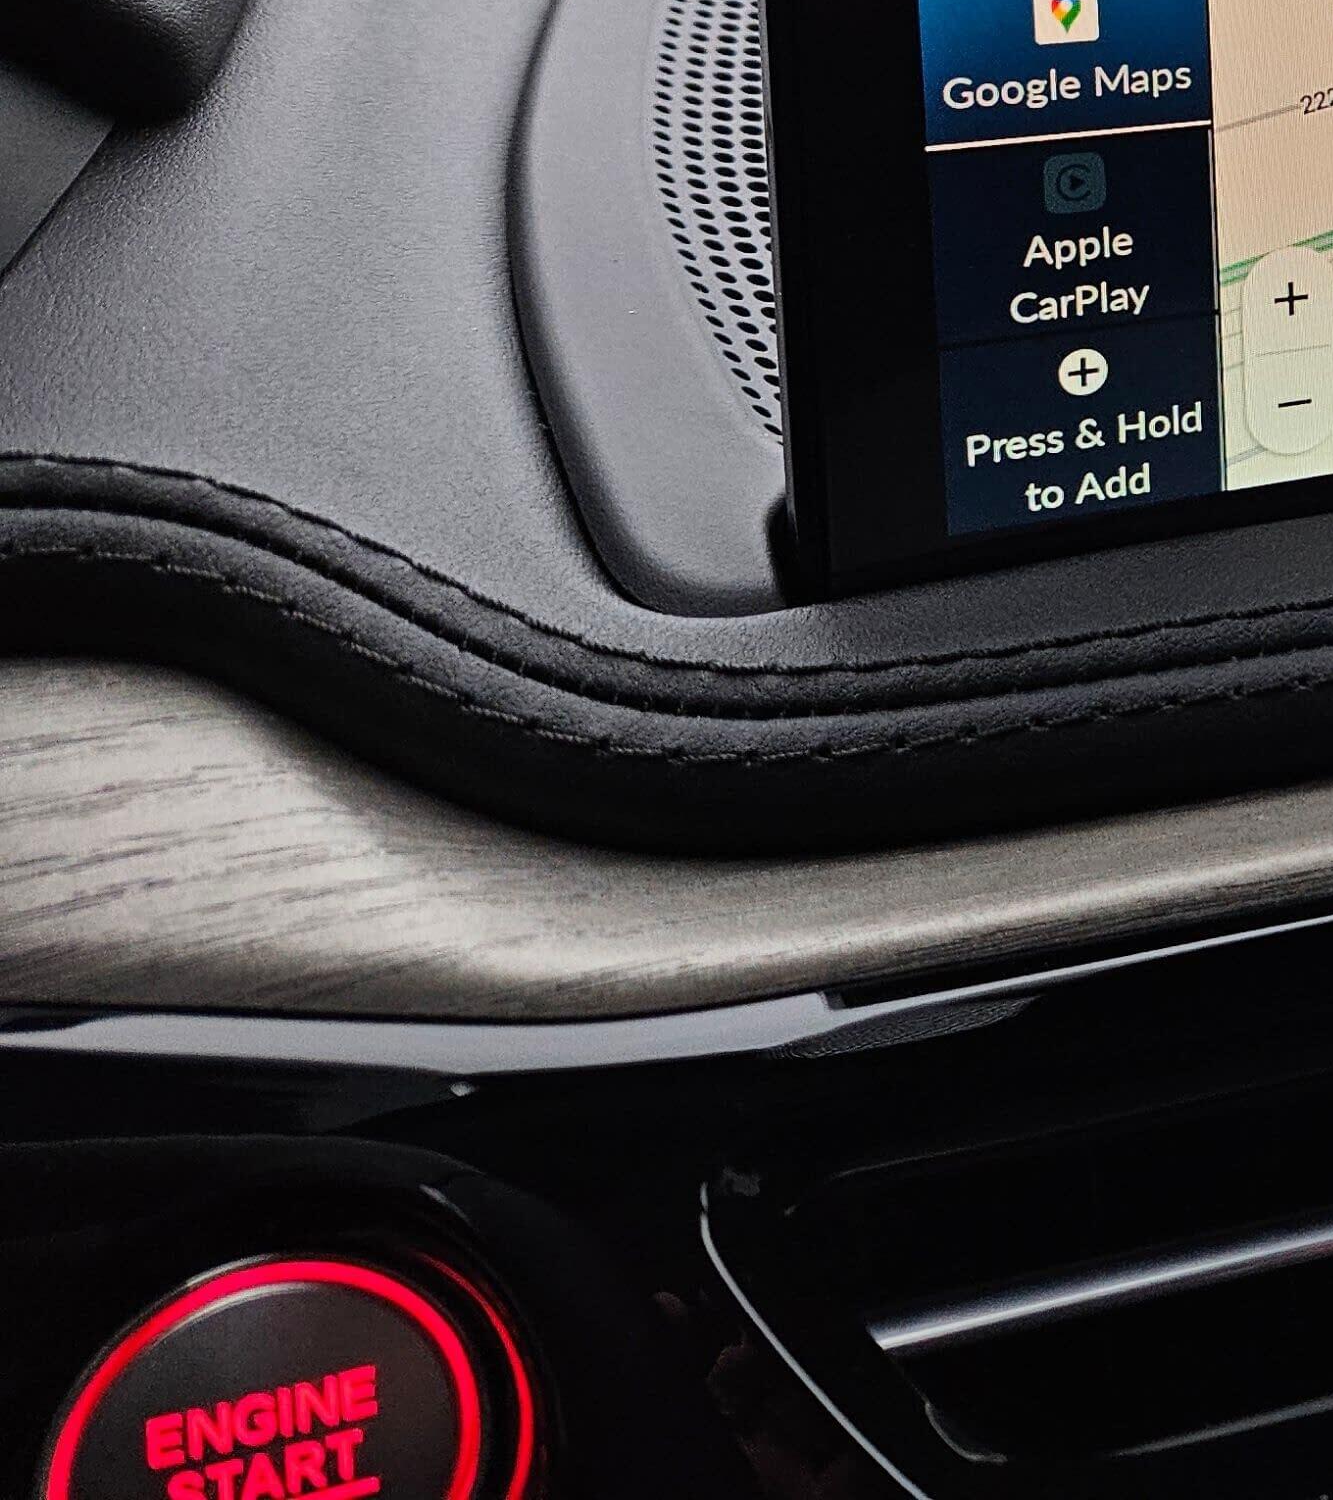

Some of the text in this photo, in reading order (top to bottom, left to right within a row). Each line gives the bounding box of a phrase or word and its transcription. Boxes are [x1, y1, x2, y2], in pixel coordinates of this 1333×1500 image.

[942, 64, 1192, 110] Google Maps
[1023, 226, 1134, 270] Apple
[1010, 281, 1150, 324] CarPlay
[966, 402, 1203, 466] Press & Hold
[1024, 463, 1150, 512] to Add
[144, 1363, 379, 1471] ENGINE
[166, 1427, 365, 1500] START
